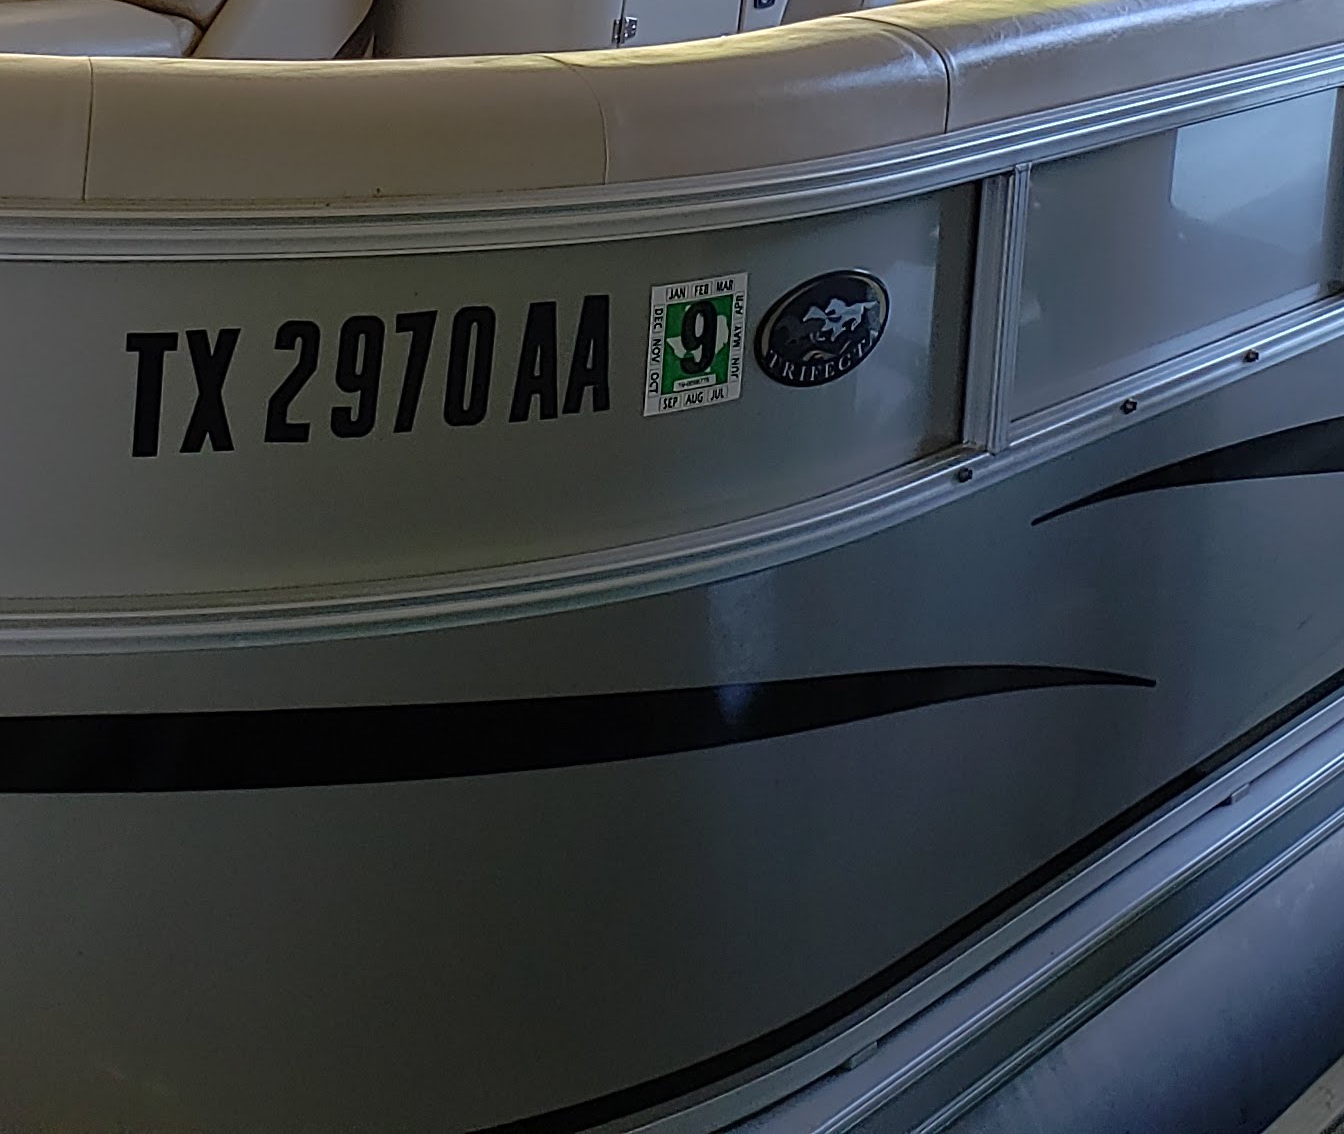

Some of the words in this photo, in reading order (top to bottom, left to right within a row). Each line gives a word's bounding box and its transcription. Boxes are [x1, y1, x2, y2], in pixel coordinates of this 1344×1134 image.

[668, 287, 686, 301] JAN
[695, 283, 709, 297] FEB
[716, 279, 734, 292] MAR
[734, 294, 744, 315] APR
[653, 307, 664, 330] DEC
[680, 300, 718, 375] 9
[733, 325, 742, 349] MAY
[651, 338, 662, 363] NOV
[126, 328, 242, 457] TX
[264, 306, 496, 443] 2970
[508, 294, 611, 423] AA
[731, 357, 740, 379] JUN
[649, 372, 660, 394] OCT
[663, 397, 678, 410] SEP
[686, 391, 703, 405] AUG
[711, 388, 724, 401] JUL
